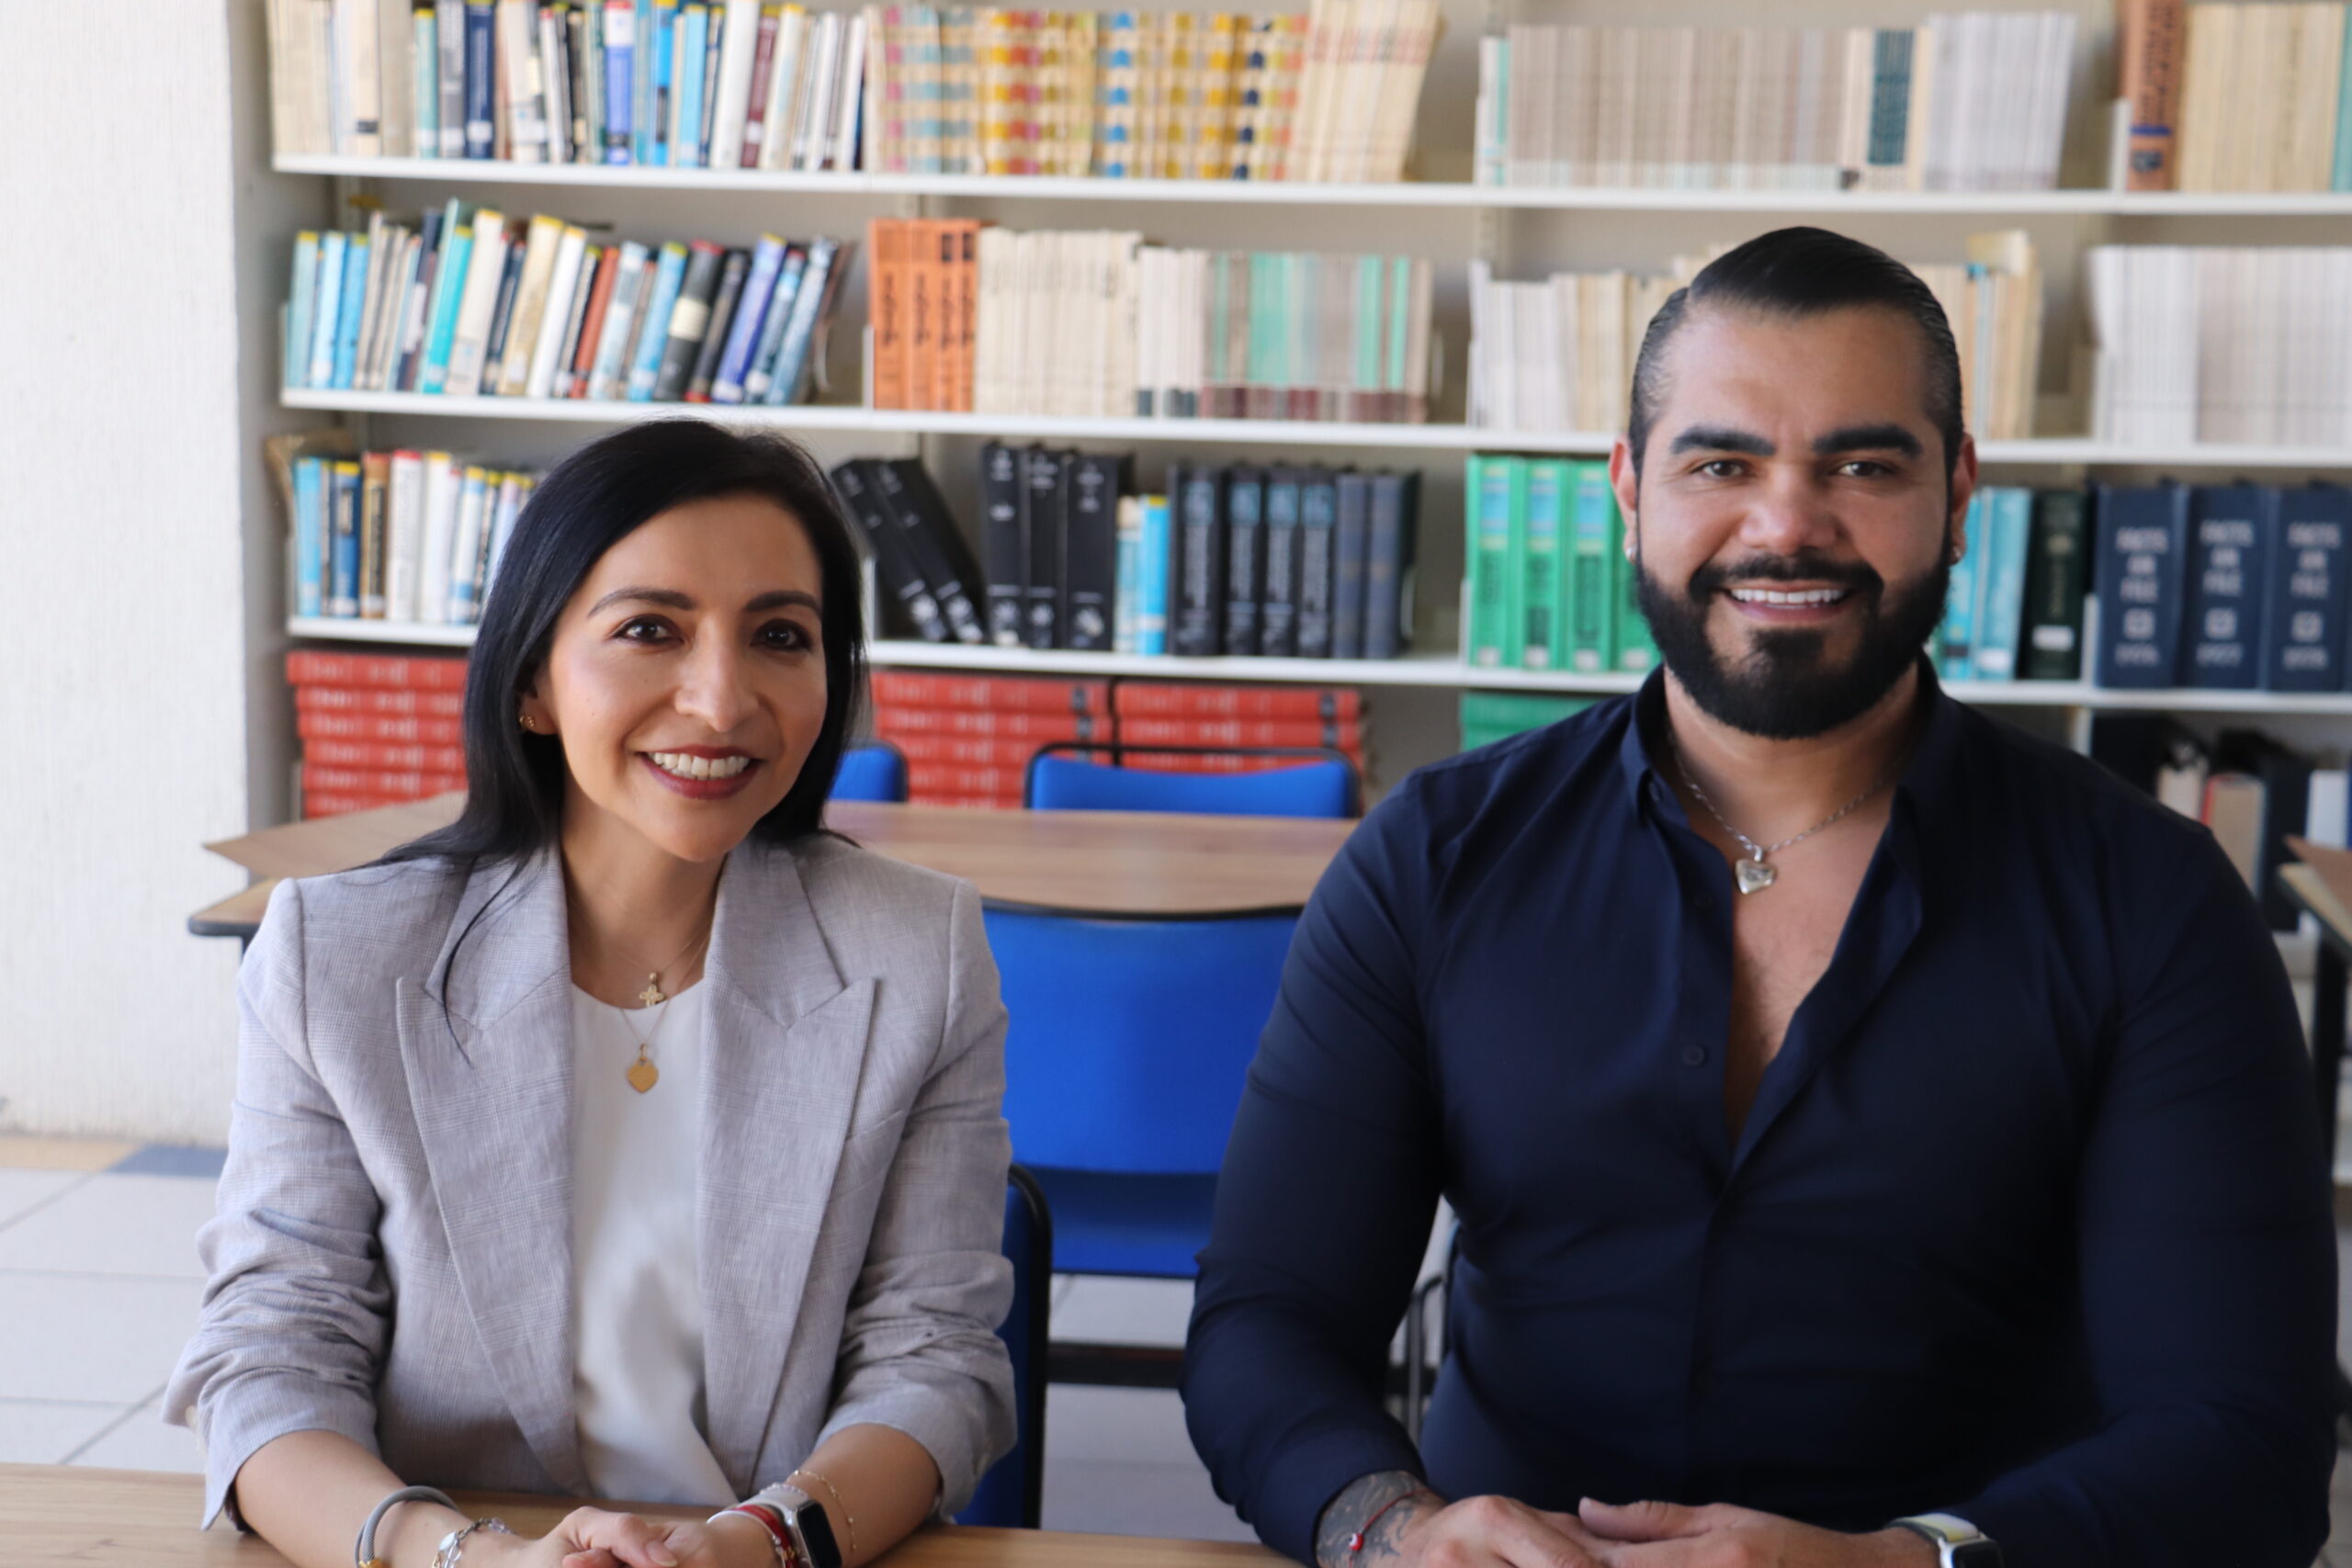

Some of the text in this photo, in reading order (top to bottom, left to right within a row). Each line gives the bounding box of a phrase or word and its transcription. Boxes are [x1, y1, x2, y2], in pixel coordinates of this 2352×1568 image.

[2116, 527, 2168, 553] FACTS
[2199, 520, 2254, 547] FACTS
[2288, 523, 2340, 547] FACTS
[2120, 578, 2158, 602] FILE
[2203, 570, 2242, 596] FILE
[2291, 572, 2328, 598] FILE
